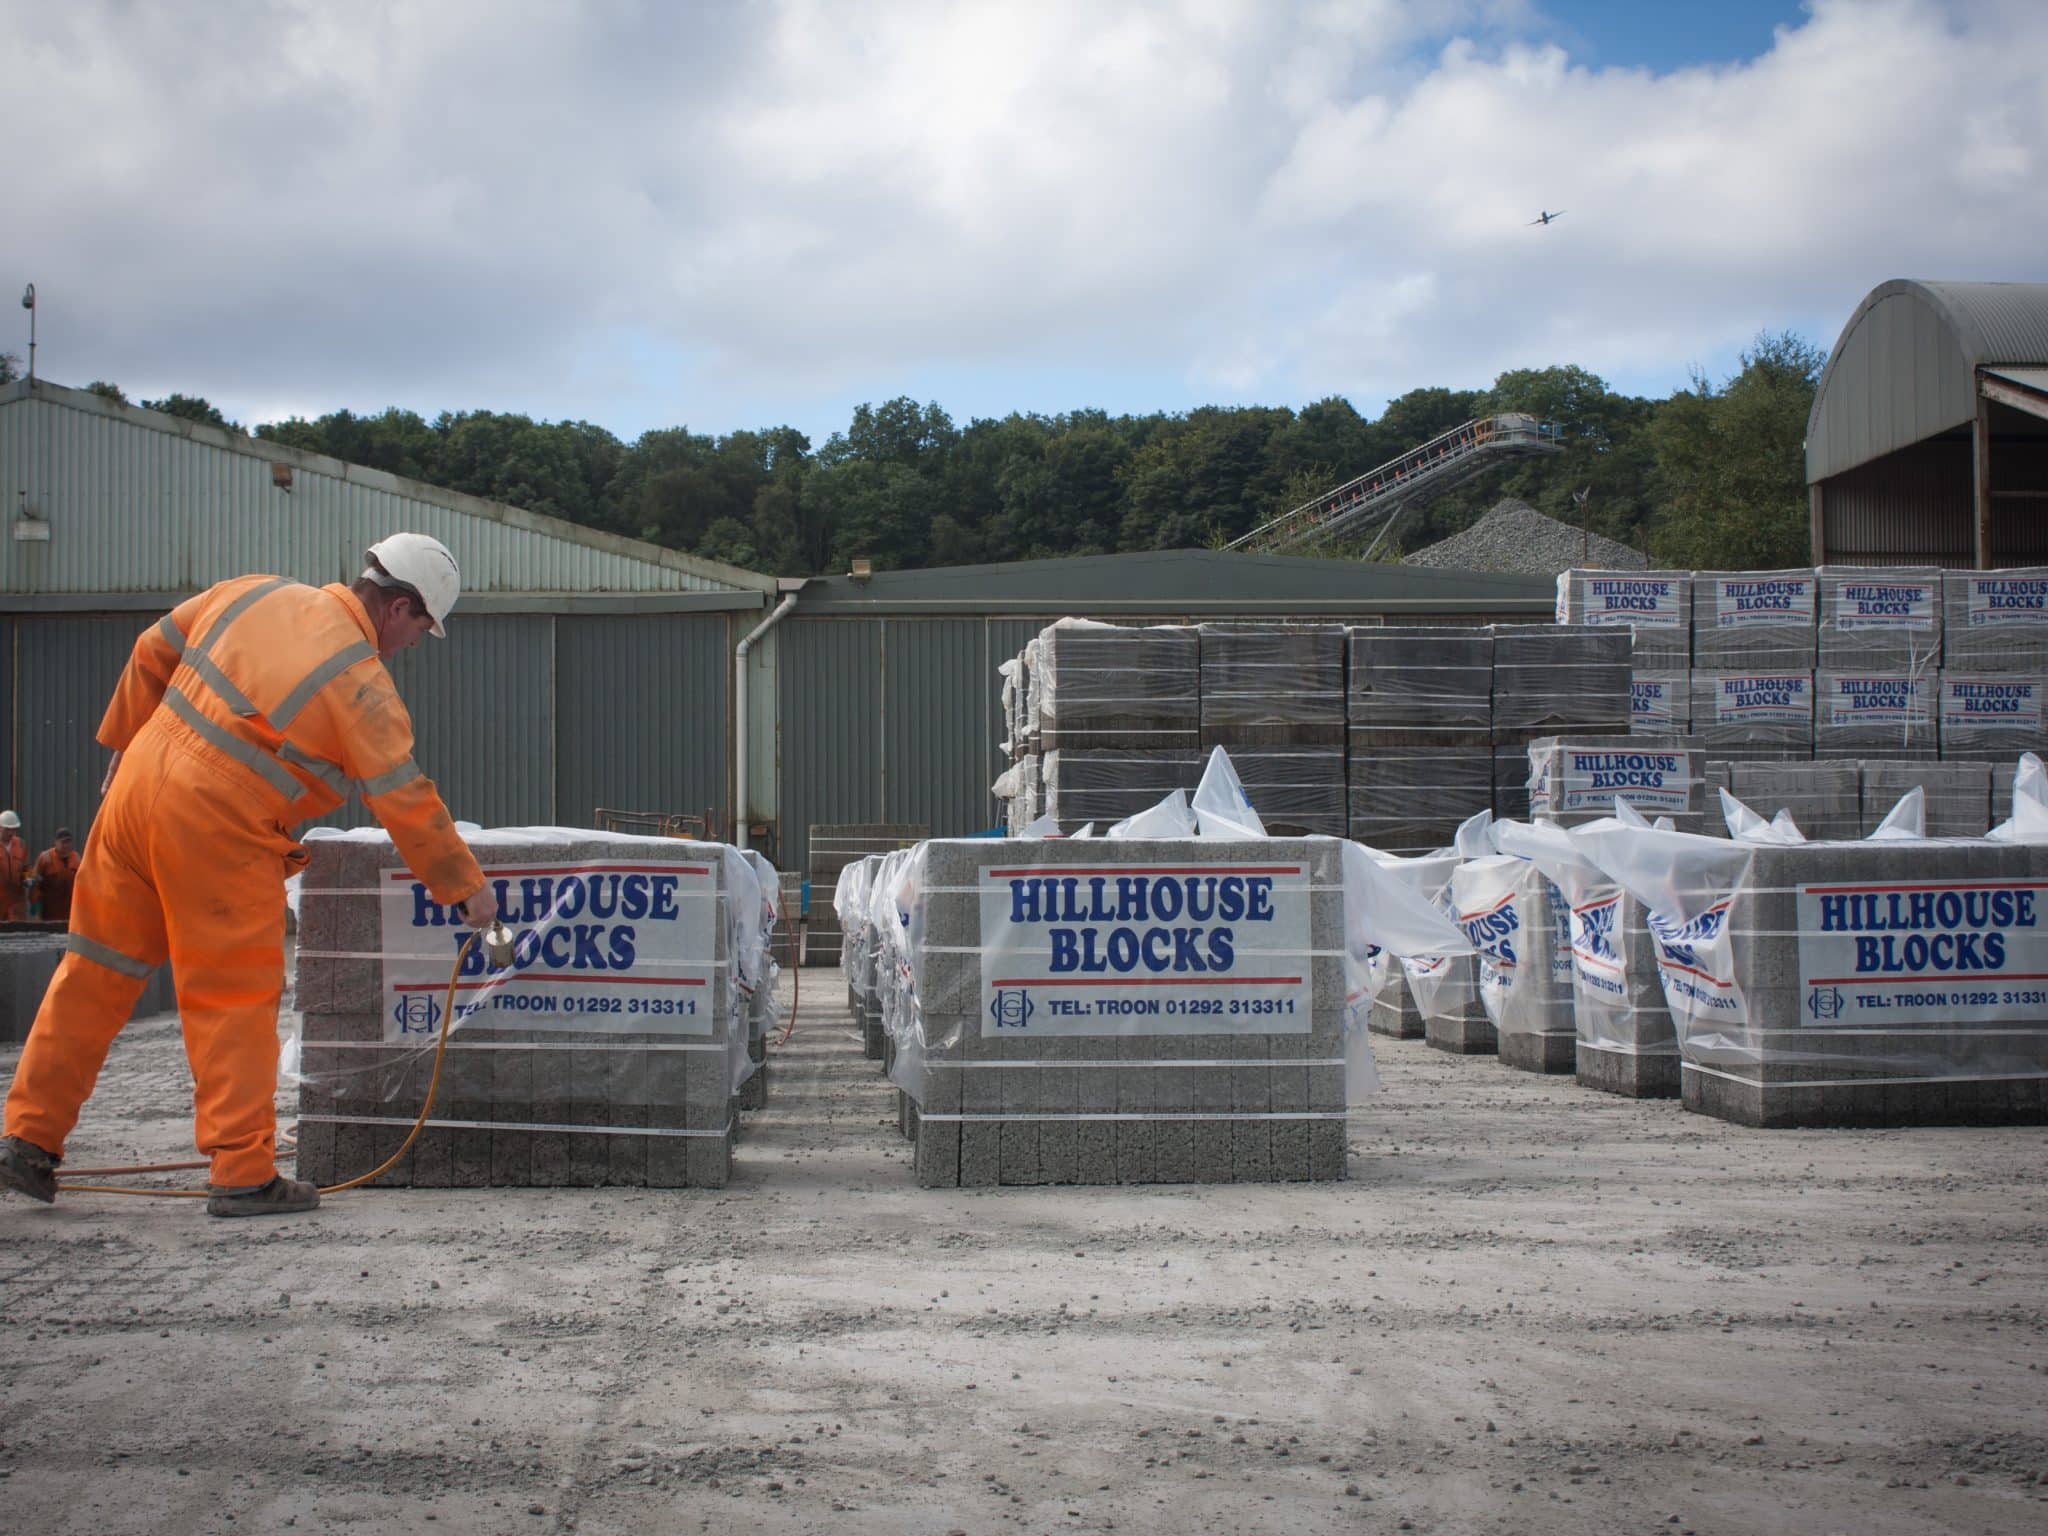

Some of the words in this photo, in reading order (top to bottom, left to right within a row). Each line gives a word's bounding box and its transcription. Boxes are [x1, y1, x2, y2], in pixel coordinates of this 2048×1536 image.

[1592, 581, 1668, 596] HILLHOUSE
[1726, 581, 1804, 597] HILLHOUSE
[1846, 587, 1923, 602] HILLHOUSE
[1977, 581, 2048, 595] HILLHOUS
[1605, 597, 1657, 610] BLOCKS
[1736, 597, 1791, 610] BLOCKS
[1857, 601, 1910, 615] BLOCKS
[1989, 595, 2044, 609] BLOCKS
[1724, 679, 1803, 694] HILLHOUSE
[1952, 685, 2032, 698] HILLHOUSE
[1735, 692, 1791, 707] BLOCKS
[1853, 695, 1906, 709] BLOCKS
[1964, 699, 2019, 712] BLOCKS
[1574, 755, 1677, 772] HILLHOUSE
[1591, 771, 1664, 788] BLOCKS
[411, 874, 679, 926] HLHOUSE
[1009, 876, 1274, 922] HILLHOUSE
[1820, 890, 2037, 931] HILLHOUSE
[454, 924, 636, 977] BOCKS
[1048, 926, 1235, 973] BLOCKS
[1855, 932, 2006, 972] BLOCKS
[493, 994, 557, 1013] TROON
[563, 997, 622, 1013] 01292
[628, 999, 696, 1015] 313311
[1856, 995, 1891, 1008] TEL:
[1894, 993, 1947, 1007] TROON
[1951, 992, 1998, 1006] 01292
[2003, 991, 2047, 1005] 31331
[1048, 1000, 1092, 1016] TEL:
[1098, 1000, 1160, 1015] TROON
[1166, 1000, 1224, 1015] 01292
[1229, 1000, 1294, 1015] 313311
